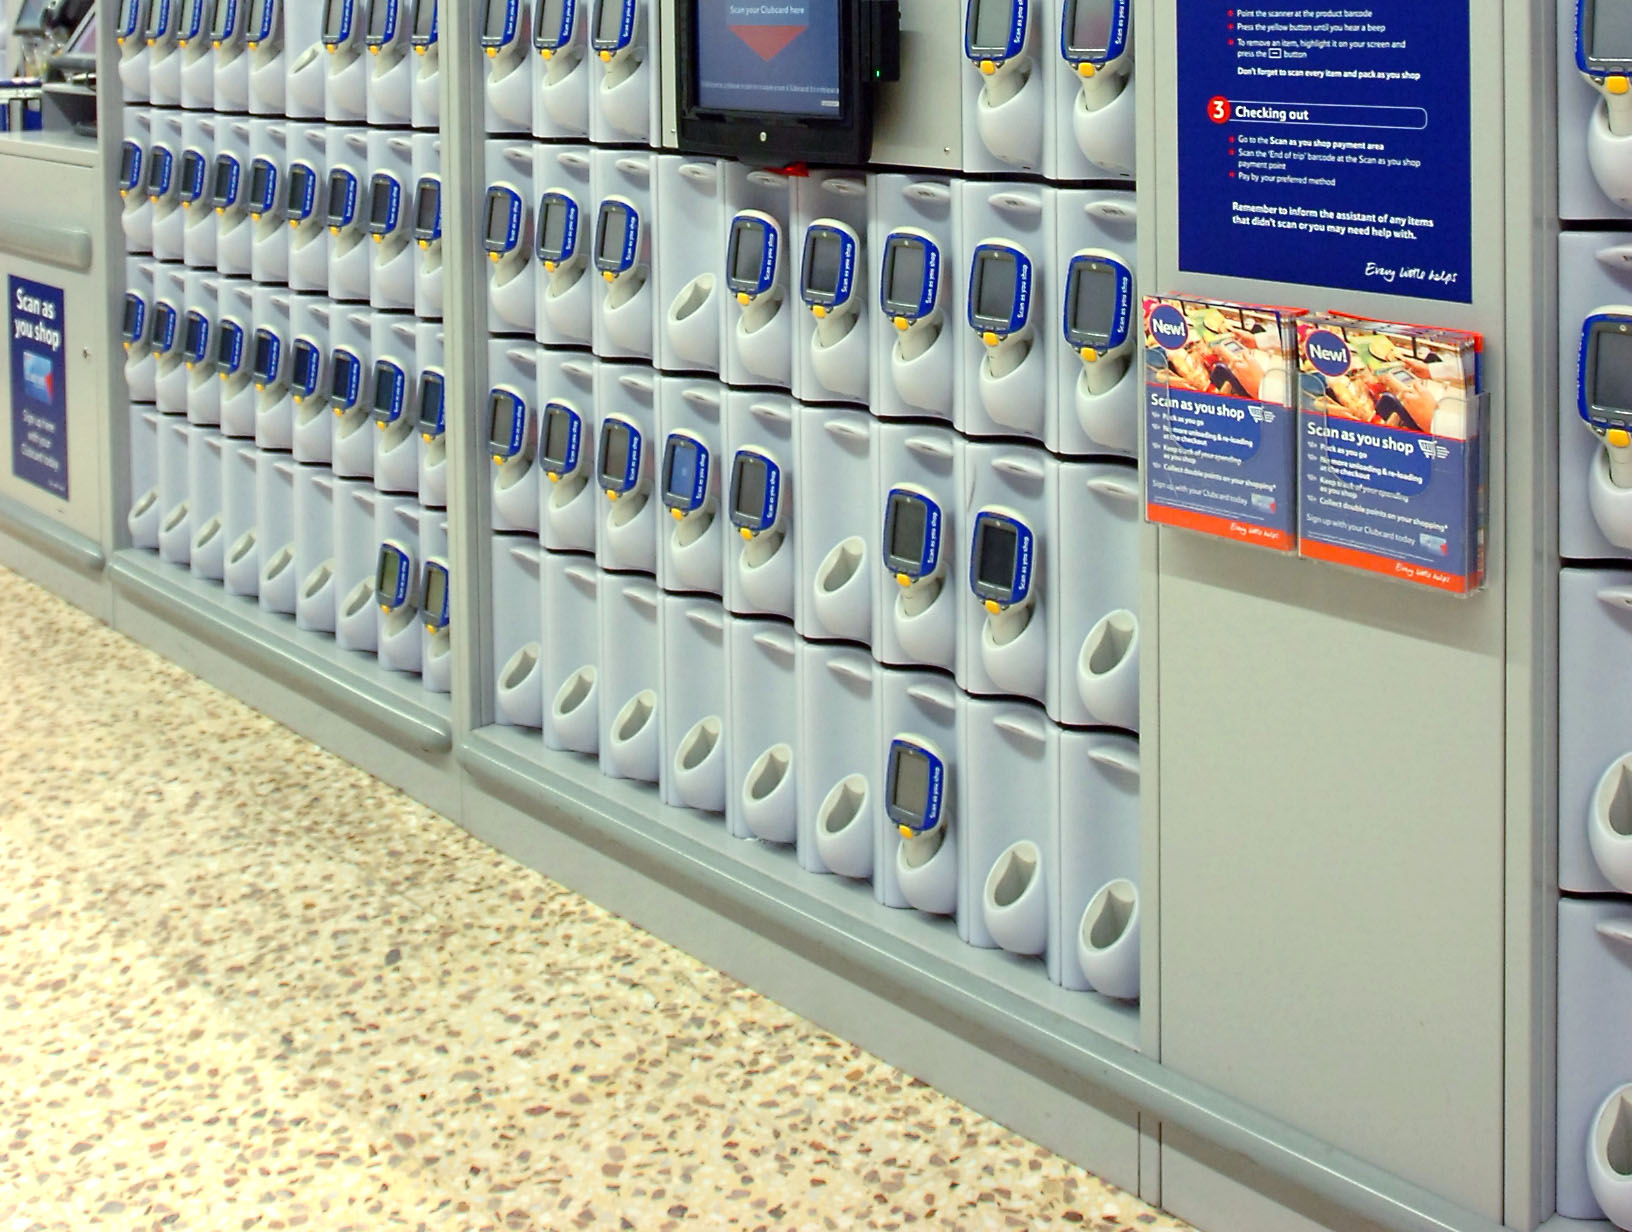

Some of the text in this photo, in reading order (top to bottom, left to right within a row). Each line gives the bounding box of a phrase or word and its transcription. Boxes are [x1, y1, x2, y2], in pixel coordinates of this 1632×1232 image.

[730, 5, 745, 15] Scan
[745, 6, 760, 16] your
[761, 5, 789, 15] Clubcard
[1237, 9, 1255, 18] Point
[1255, 10, 1267, 18] the
[1303, 9, 1314, 18] the
[1316, 9, 1343, 19] product
[1255, 23, 1266, 31] the
[1330, 25, 1343, 33] you
[1367, 23, 1386, 33] beep
[1257, 67, 1278, 77] forget
[1279, 68, 1287, 76] to
[1287, 69, 1304, 77] scan
[1305, 70, 1324, 79] every
[1343, 69, 1357, 78] and
[1358, 69, 1376, 79] pack
[1386, 71, 1400, 80] you
[1401, 70, 1421, 81] shop
[1213, 101, 1309, 122] 3 Checking out
[1238, 134, 1248, 143] Go
[1249, 136, 1256, 144] to
[1257, 136, 1268, 144] the
[1270, 136, 1288, 145] Scan
[1298, 139, 1312, 147] you
[1313, 139, 1331, 149] shop
[1332, 141, 1365, 150] payment
[1367, 143, 1384, 151] area
[1232, 201, 1434, 227] Remember to inform the assistant of any items
[1232, 215, 1417, 240] that didn't scan or you may need help with.
[1365, 262, 1458, 285] Every little helps
[16, 287, 55, 319] Scan as
[14, 318, 60, 351] you shop
[1152, 317, 1186, 338] New!
[1309, 345, 1348, 364] New!
[1151, 393, 1245, 421] Scan as you shop
[1307, 422, 1414, 456] Scan as you shop
